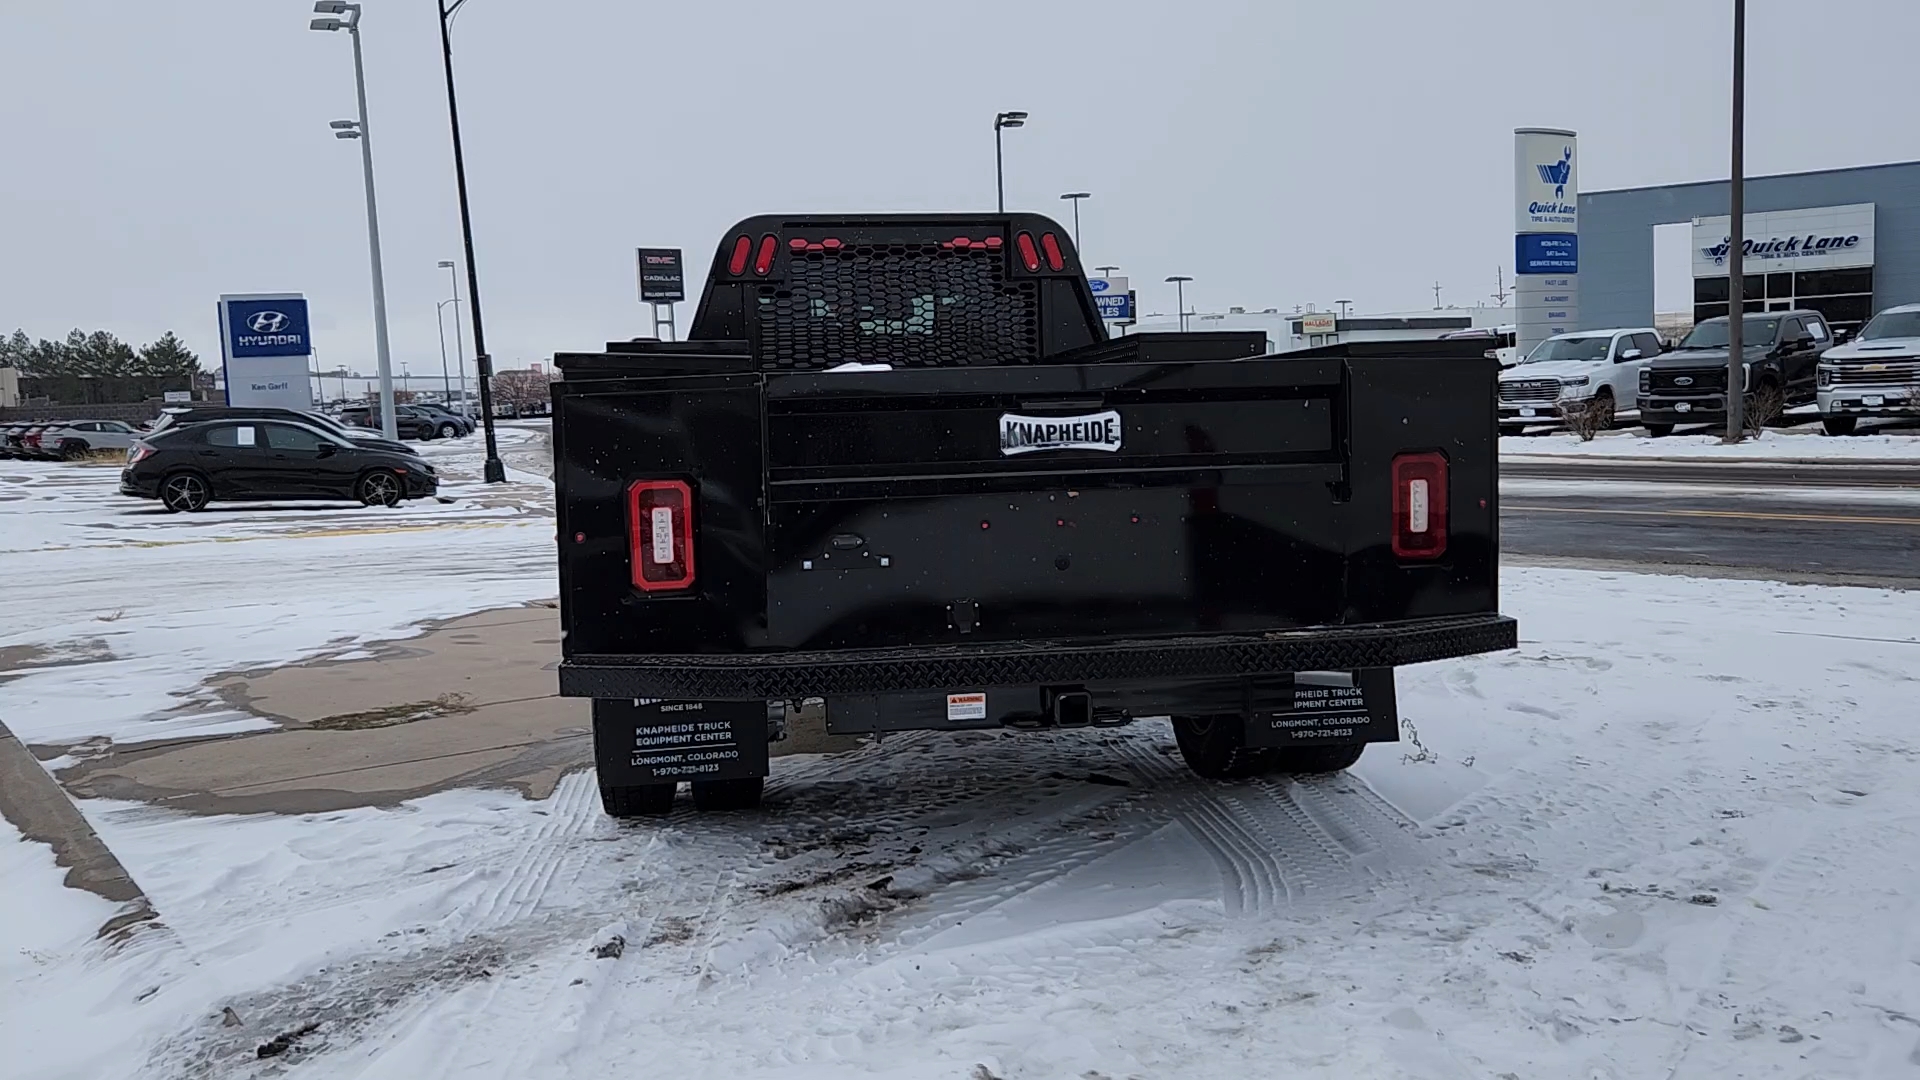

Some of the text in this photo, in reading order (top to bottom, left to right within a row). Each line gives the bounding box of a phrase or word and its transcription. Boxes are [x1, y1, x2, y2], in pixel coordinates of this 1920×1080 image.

[1529, 201, 1576, 214] Quick Lane
[1742, 235, 1858, 256] Quick Lane
[647, 256, 675, 264] GMC
[1095, 297, 1124, 306] WNED
[239, 334, 301, 346] HYUNDAI
[268, 382, 288, 390] Garff
[1006, 418, 1115, 448] KNAPHEIDE
[1295, 688, 1362, 698] PHEIDE TRUCK
[660, 704, 684, 712] SINCE
[1294, 698, 1363, 709] IPMENT CENTER
[636, 721, 731, 735] KNAPHEIDE TRUCK
[1271, 716, 1370, 728] LONGMONT, COLORADO
[636, 732, 732, 746] EQUIPMENT CENTER
[1290, 728, 1353, 738] 1-970-721-8123
[631, 751, 738, 766] LONGMONT, COLORADO
